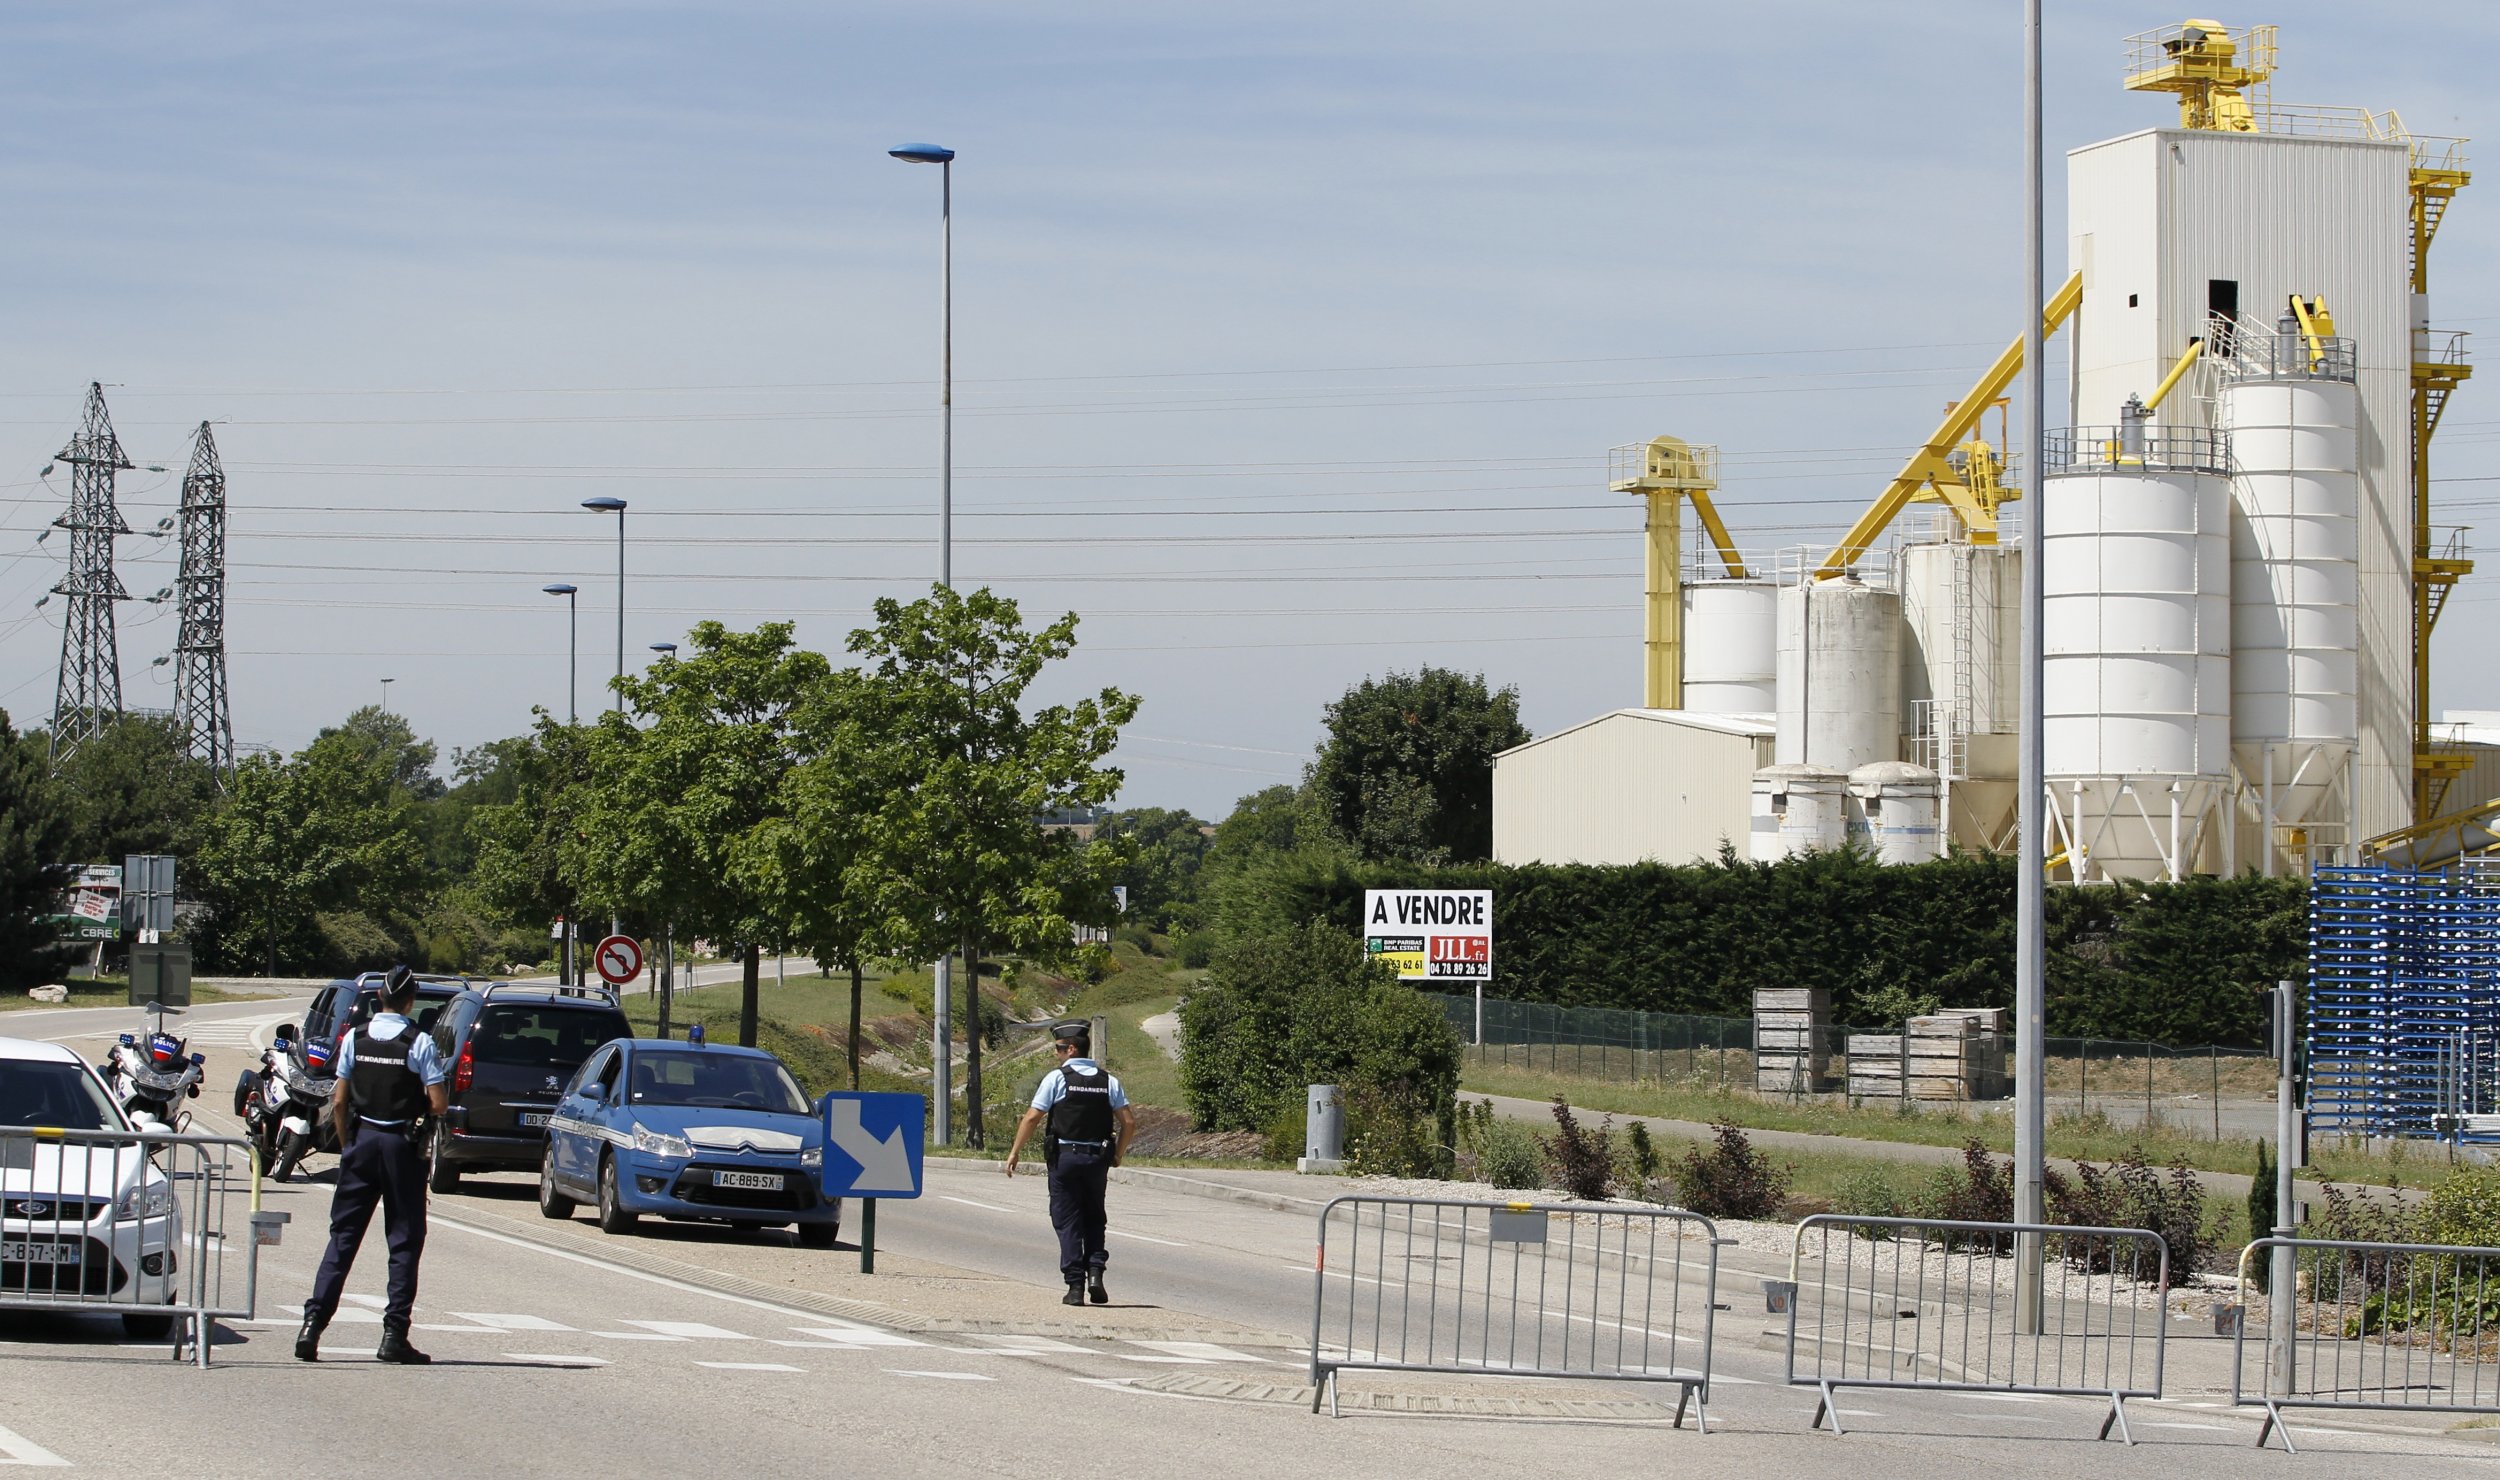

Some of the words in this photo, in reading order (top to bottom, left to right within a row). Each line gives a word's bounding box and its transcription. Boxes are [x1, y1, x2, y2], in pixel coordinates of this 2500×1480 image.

[1372, 896, 1388, 924] A
[1396, 896, 1484, 925] VENDRE
[81, 928, 113, 938] CBRE
[1403, 959, 1412, 969] 62
[1415, 959, 1423, 969] 61
[1430, 962, 1440, 974] 04
[1442, 963, 1451, 974] 78
[1453, 963, 1463, 974] 89
[1465, 963, 1475, 974] 26
[1477, 963, 1487, 974] 26
[153, 1038, 176, 1049] POLICE
[308, 1044, 330, 1056] POLICE
[355, 1054, 405, 1066] GENDARMERIE
[1068, 1085, 1109, 1094] GENDARMERIE
[722, 1173, 775, 1188] AC-889-SX
